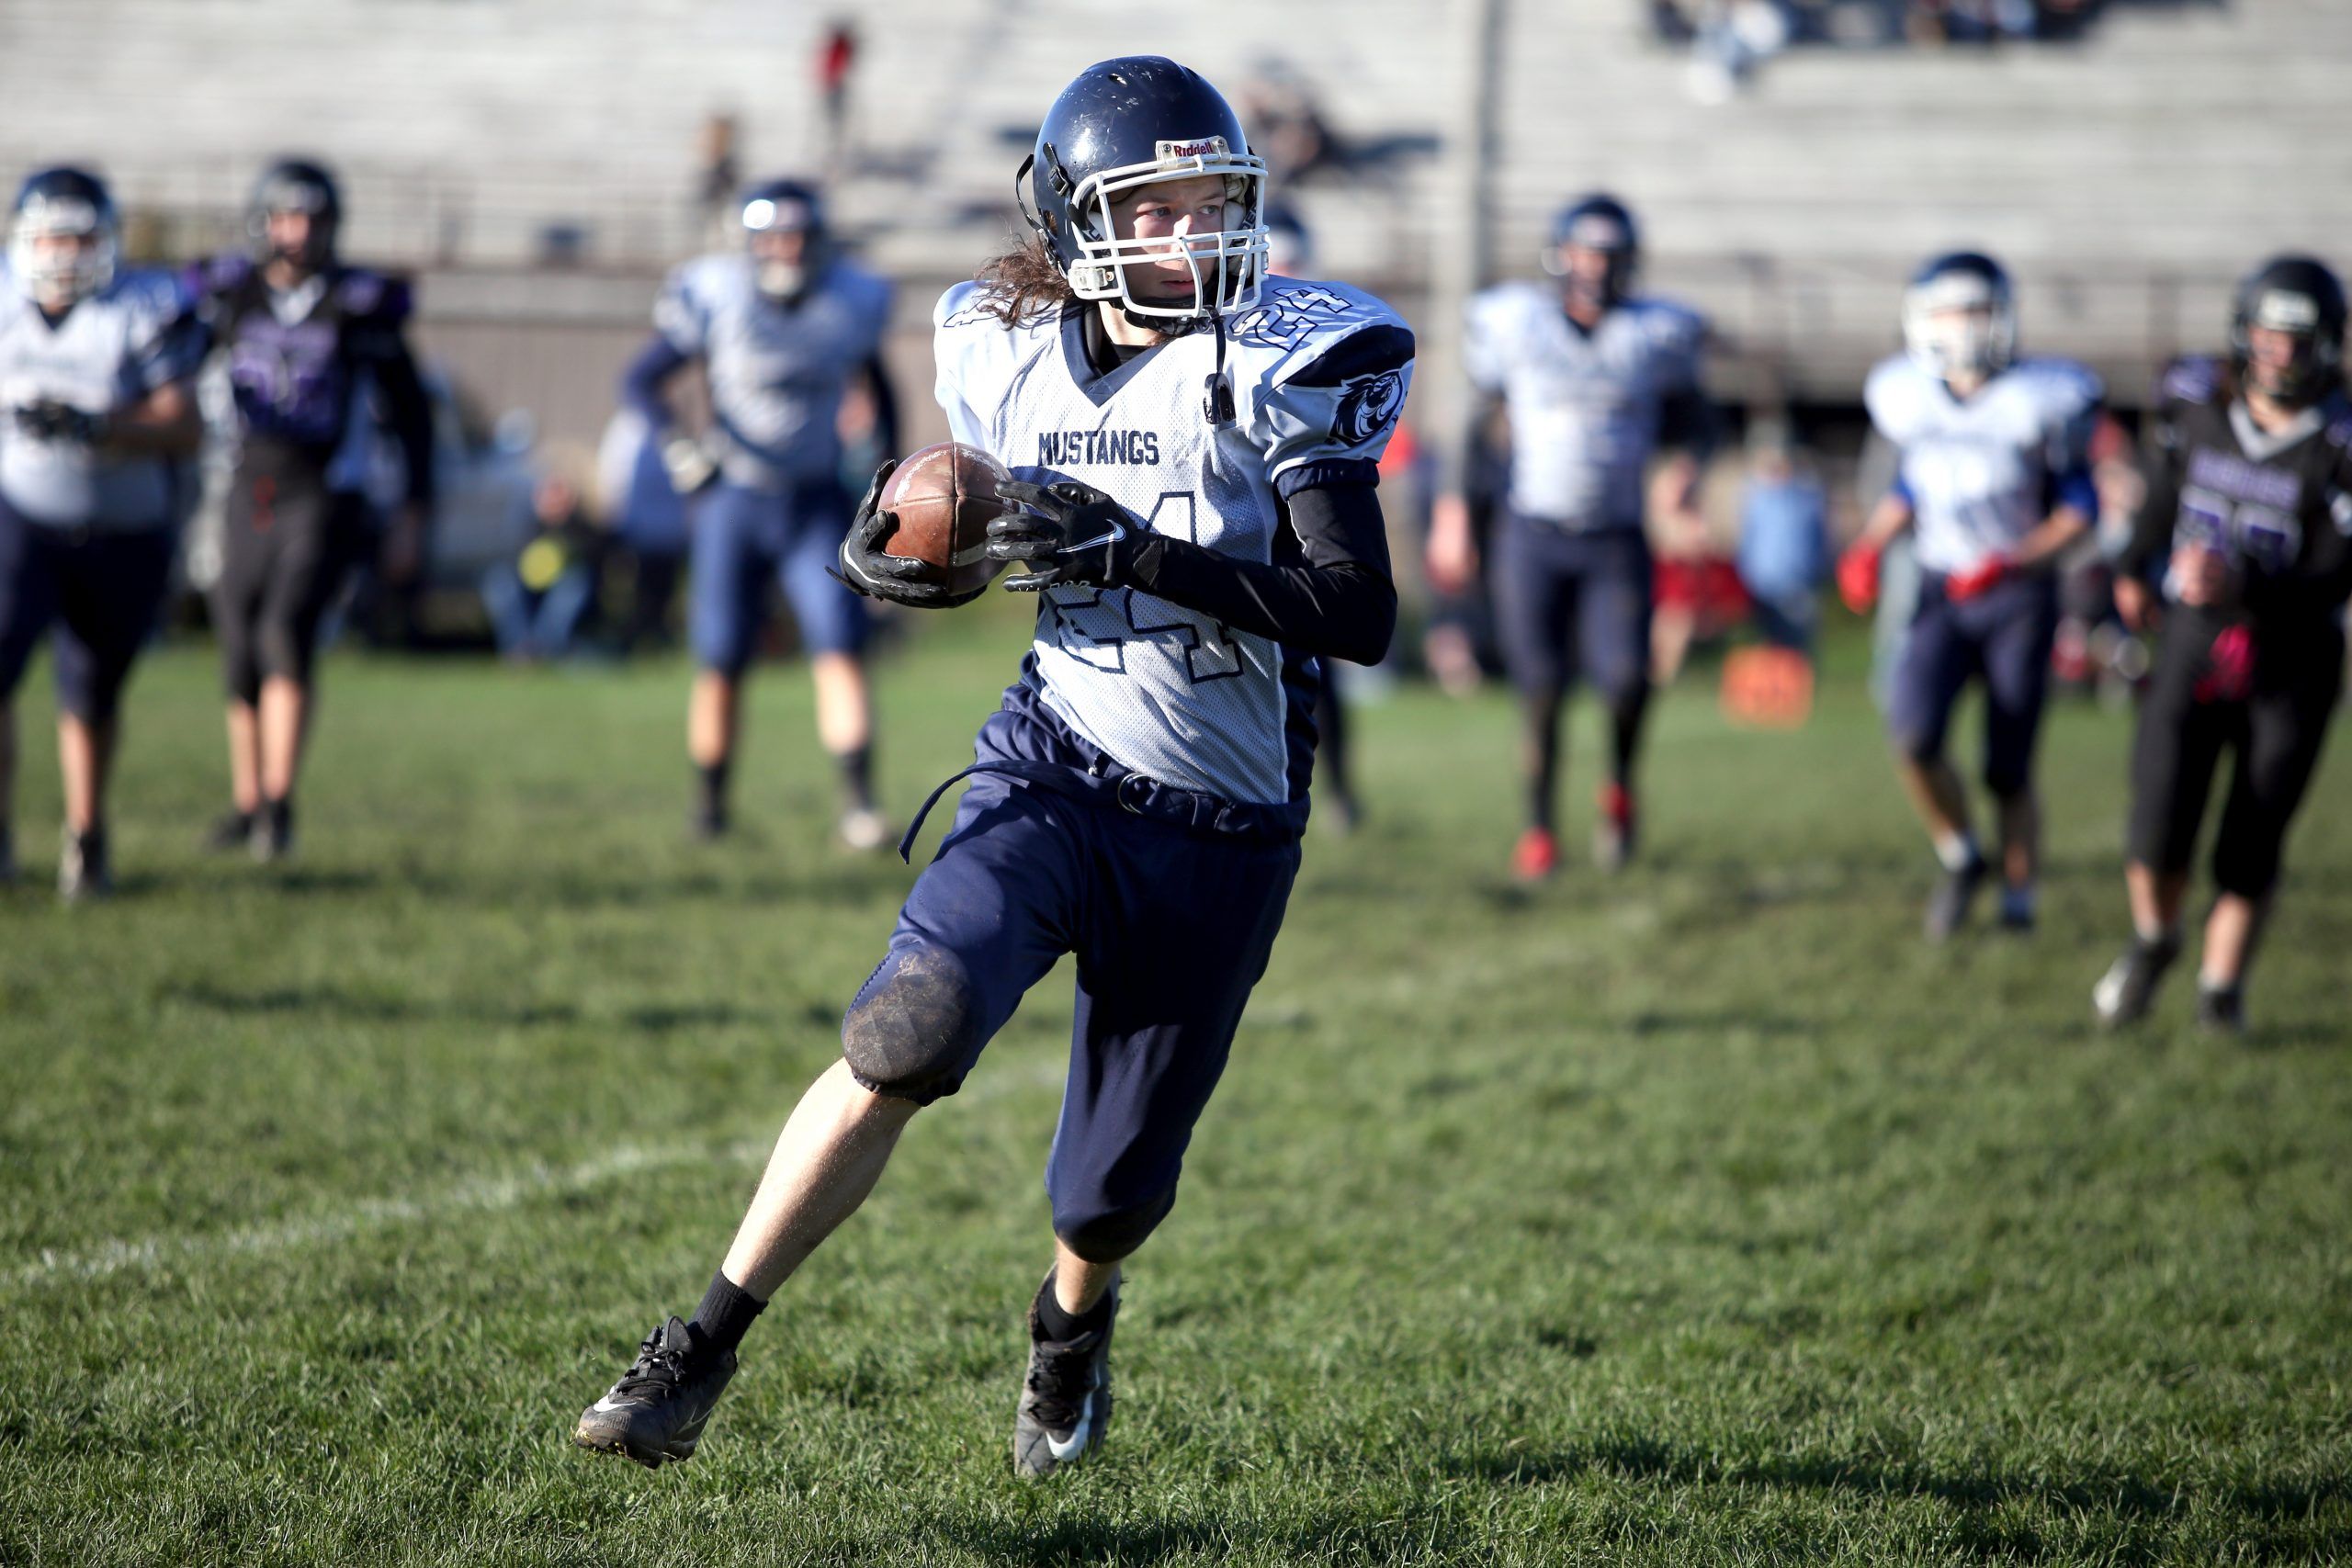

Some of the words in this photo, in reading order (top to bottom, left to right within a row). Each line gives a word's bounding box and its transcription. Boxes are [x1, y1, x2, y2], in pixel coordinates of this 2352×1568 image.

[1174, 140, 1214, 157] Riddell
[1229, 285, 1352, 353] 24
[1037, 430, 1159, 466] MUSTANGS
